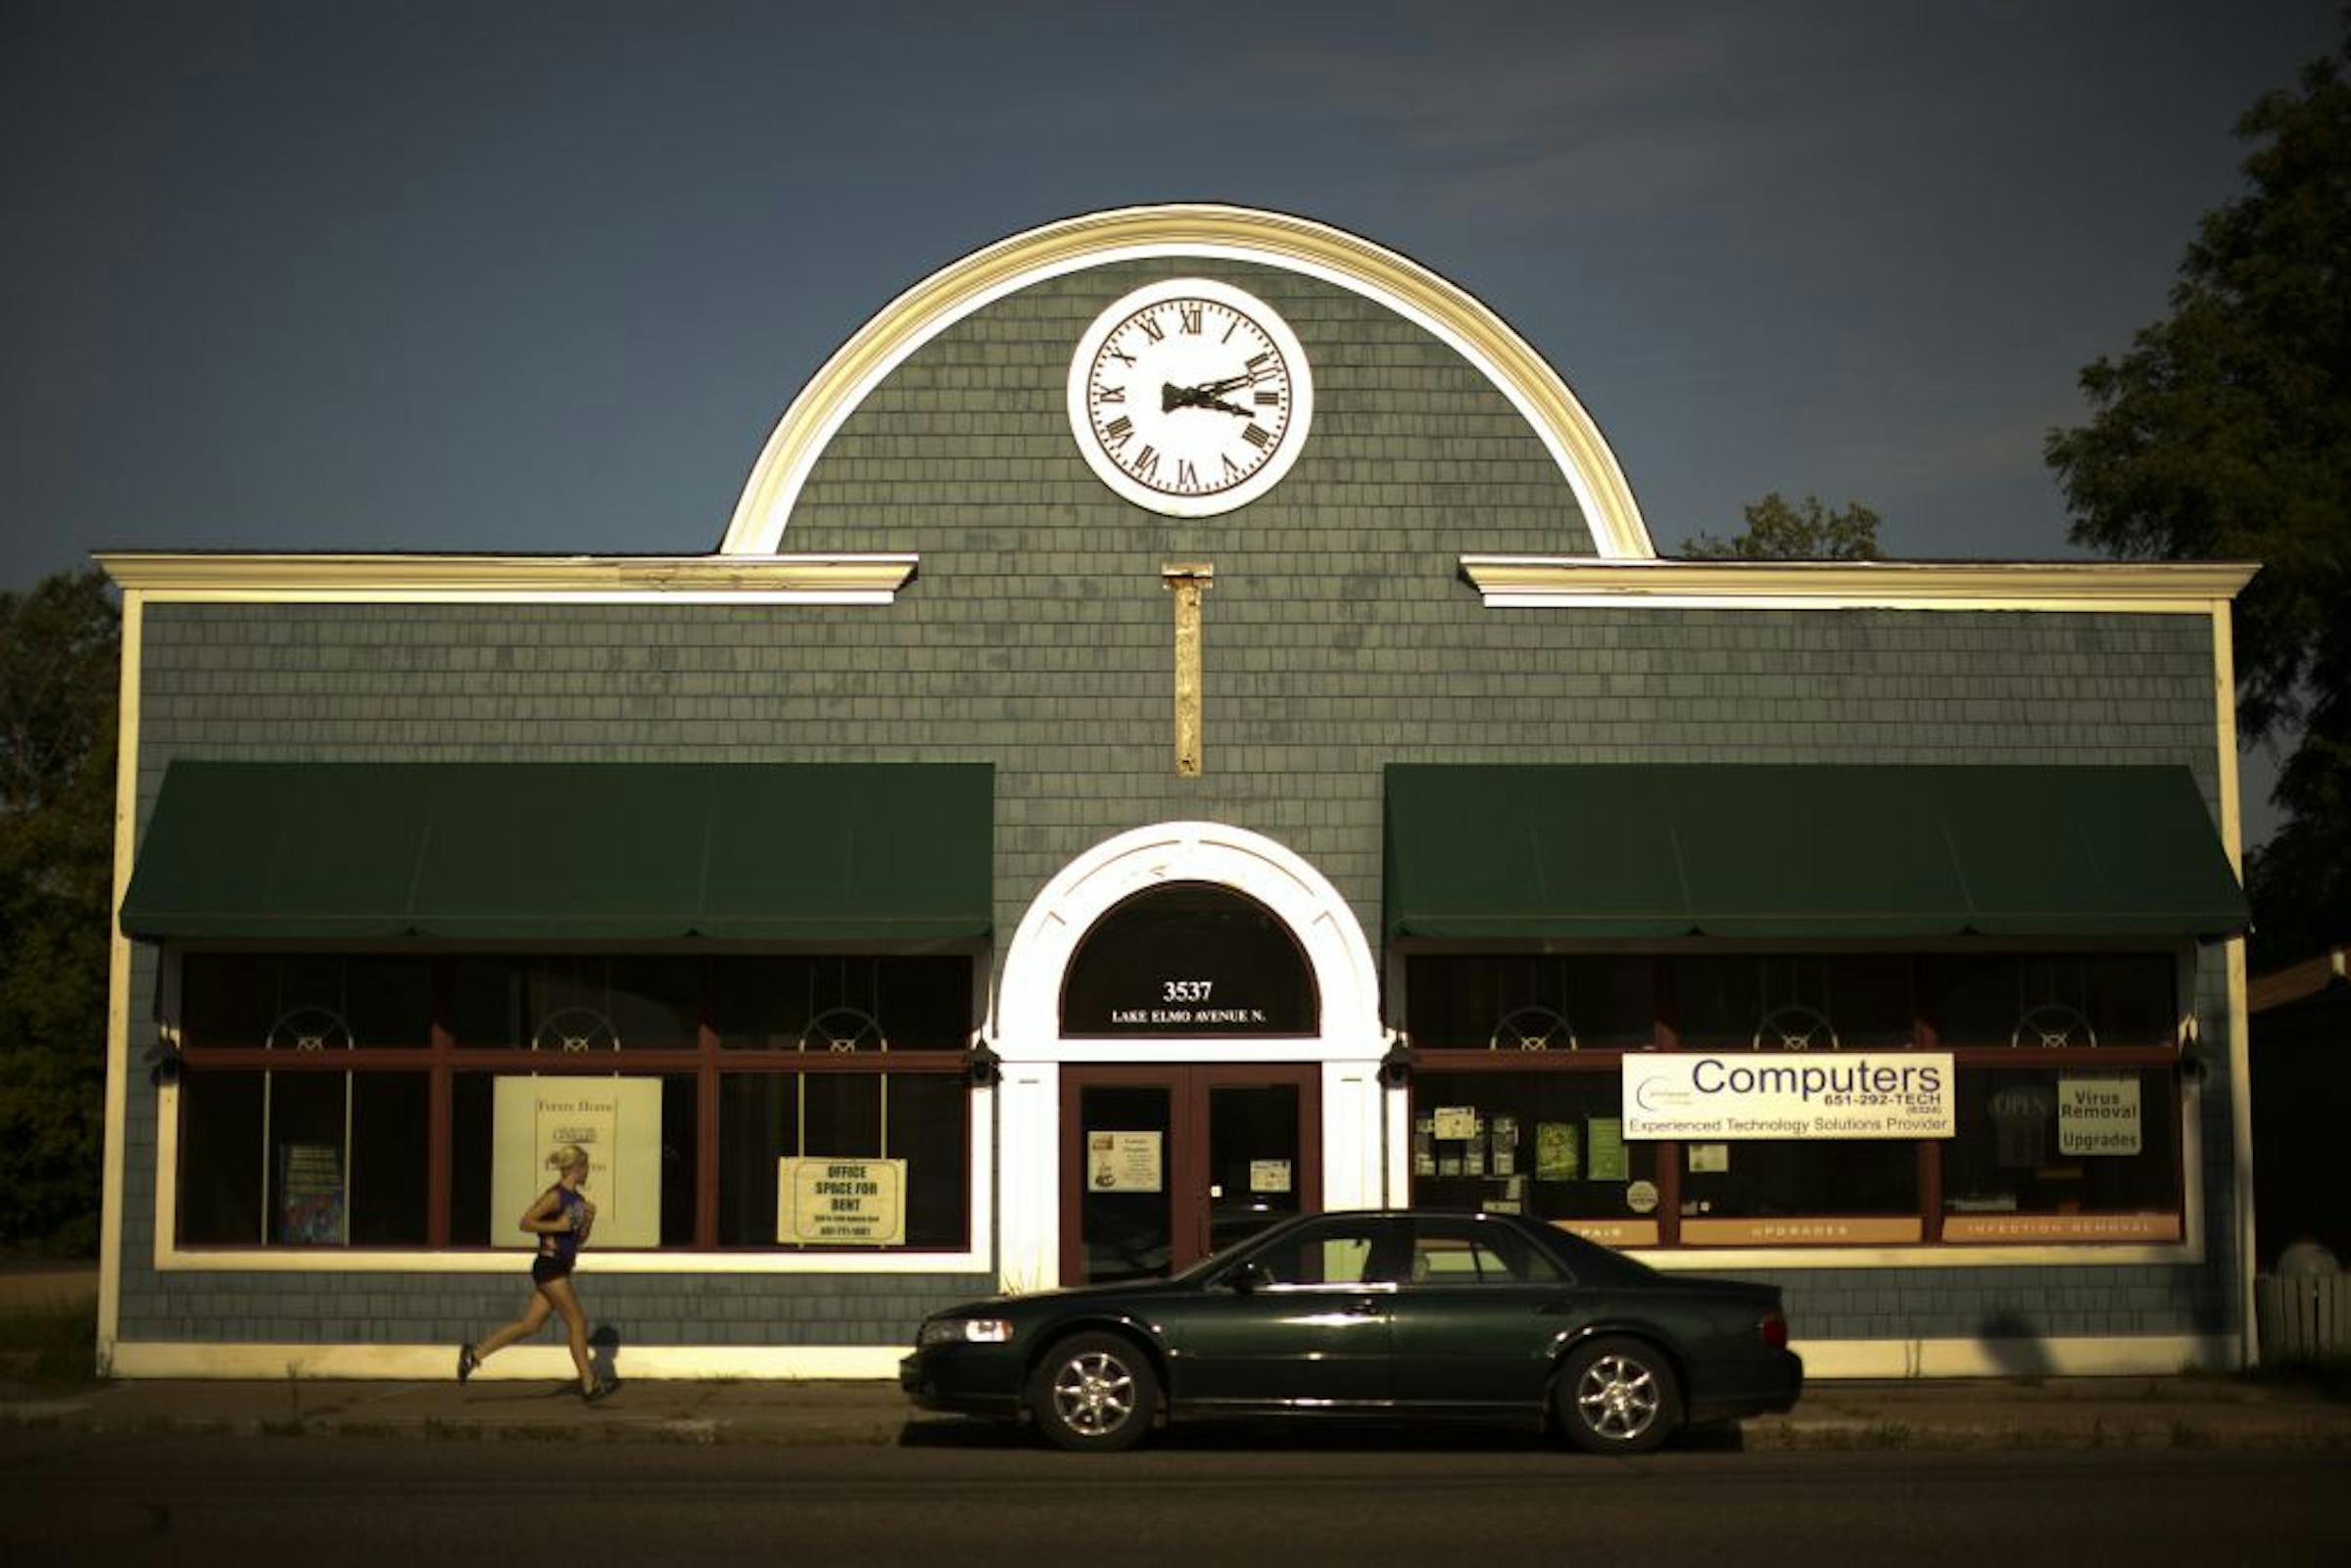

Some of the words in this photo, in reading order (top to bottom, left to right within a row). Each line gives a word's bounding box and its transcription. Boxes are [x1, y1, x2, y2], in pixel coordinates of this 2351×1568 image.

[1179, 309, 1202, 334] XII
[1222, 321, 1238, 345] I
[1110, 347, 1136, 368] X
[1099, 386, 1126, 403] IX
[1254, 392, 1279, 405] III
[1178, 458, 1198, 485] VI
[1221, 452, 1239, 477] V
[1163, 980, 1214, 1002] 3537
[1112, 1010, 1148, 1023] LAKE
[1151, 1010, 1192, 1023] ELMO
[1194, 1009, 1248, 1023] AVENUE
[1251, 1009, 1267, 1022] N.
[1693, 1059, 1942, 1101] Computers
[1824, 1094, 1942, 1106] 651-292-TECH
[2075, 1090, 2121, 1105] Virus
[2061, 1104, 2137, 1119] Removal
[1629, 1118, 1721, 1134] Experienced
[1727, 1117, 1809, 1136] Technology
[1814, 1117, 1882, 1131] Solutions
[1887, 1117, 1946, 1131] Provider
[2063, 1131, 2137, 1150] Upgrades
[815, 1181, 852, 1195] SPACE
[855, 1181, 878, 1195] FOR
[831, 1198, 861, 1212] RENT
